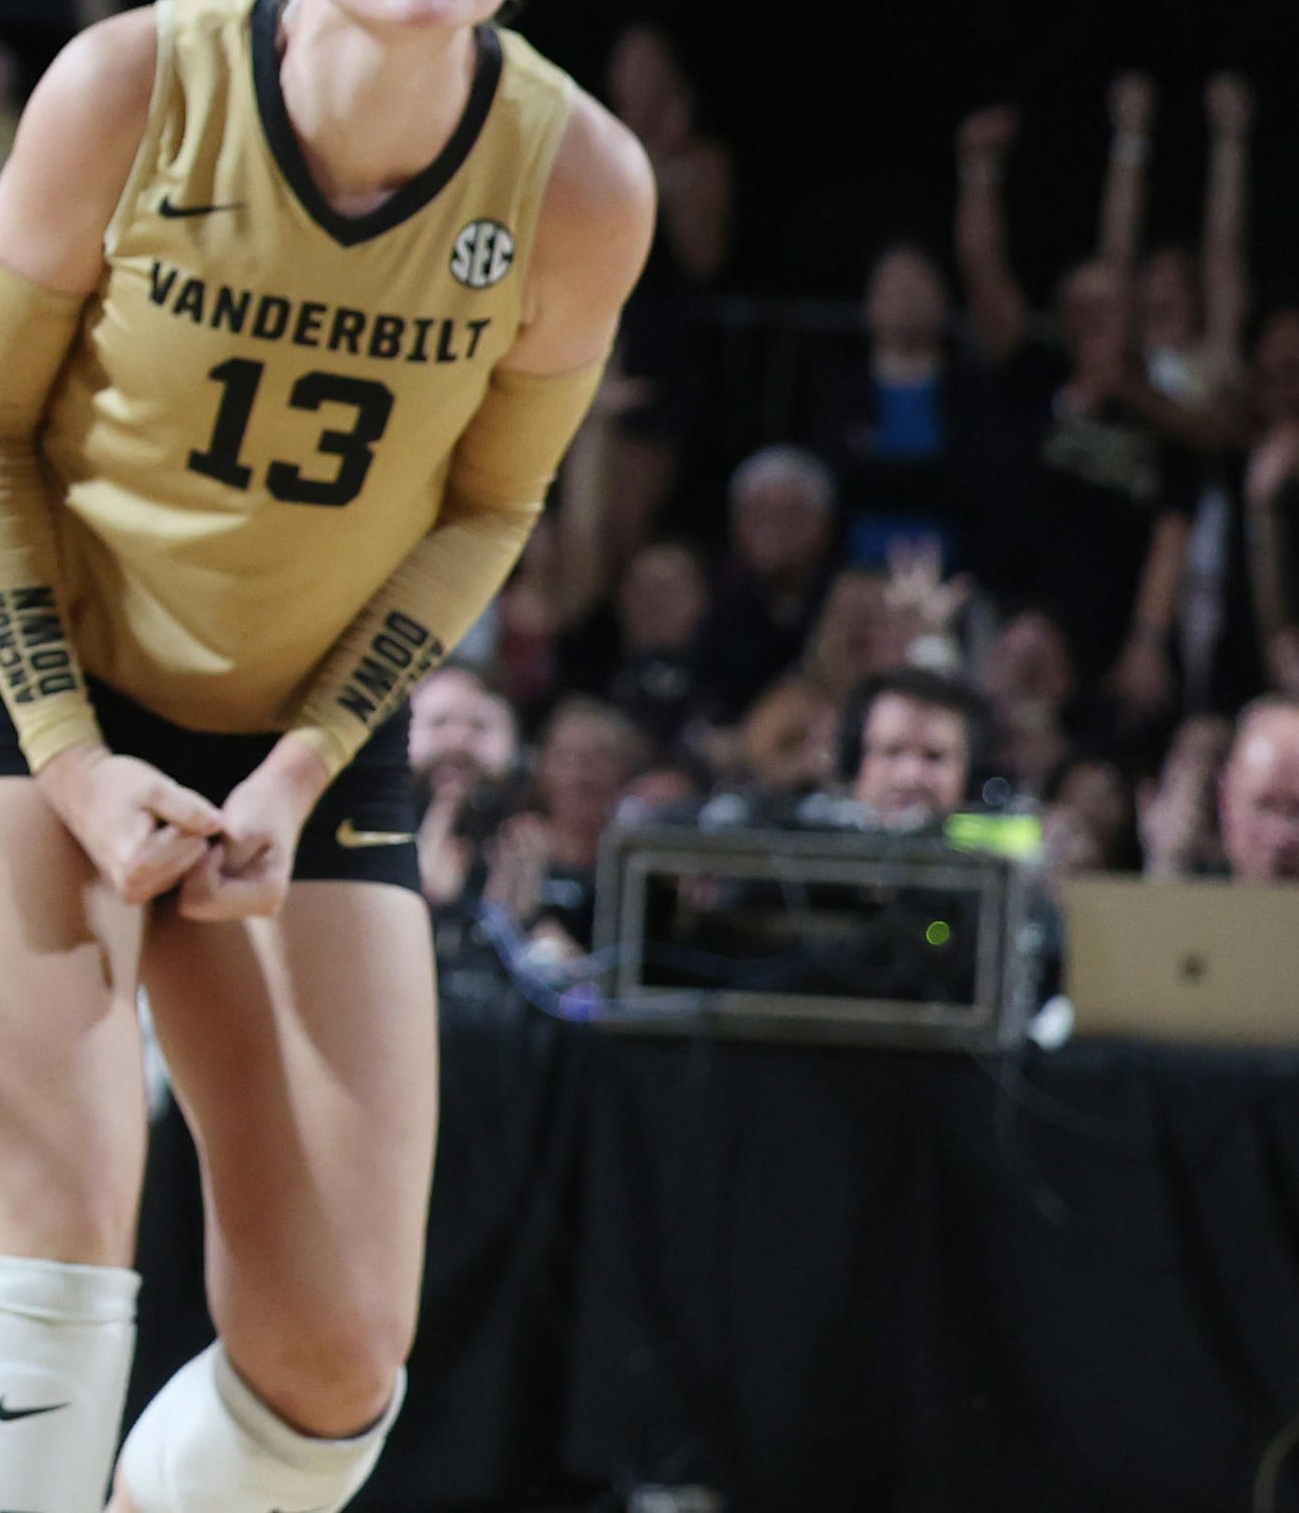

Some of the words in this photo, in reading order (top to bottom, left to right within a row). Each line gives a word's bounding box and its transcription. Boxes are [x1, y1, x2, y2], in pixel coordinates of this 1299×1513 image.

[450, 220, 514, 288] SEC
[147, 261, 493, 364] VANDERBILT
[186, 356, 396, 507] 13
[11, 586, 77, 697] DOWN
[336, 610, 430, 725] DOWN
